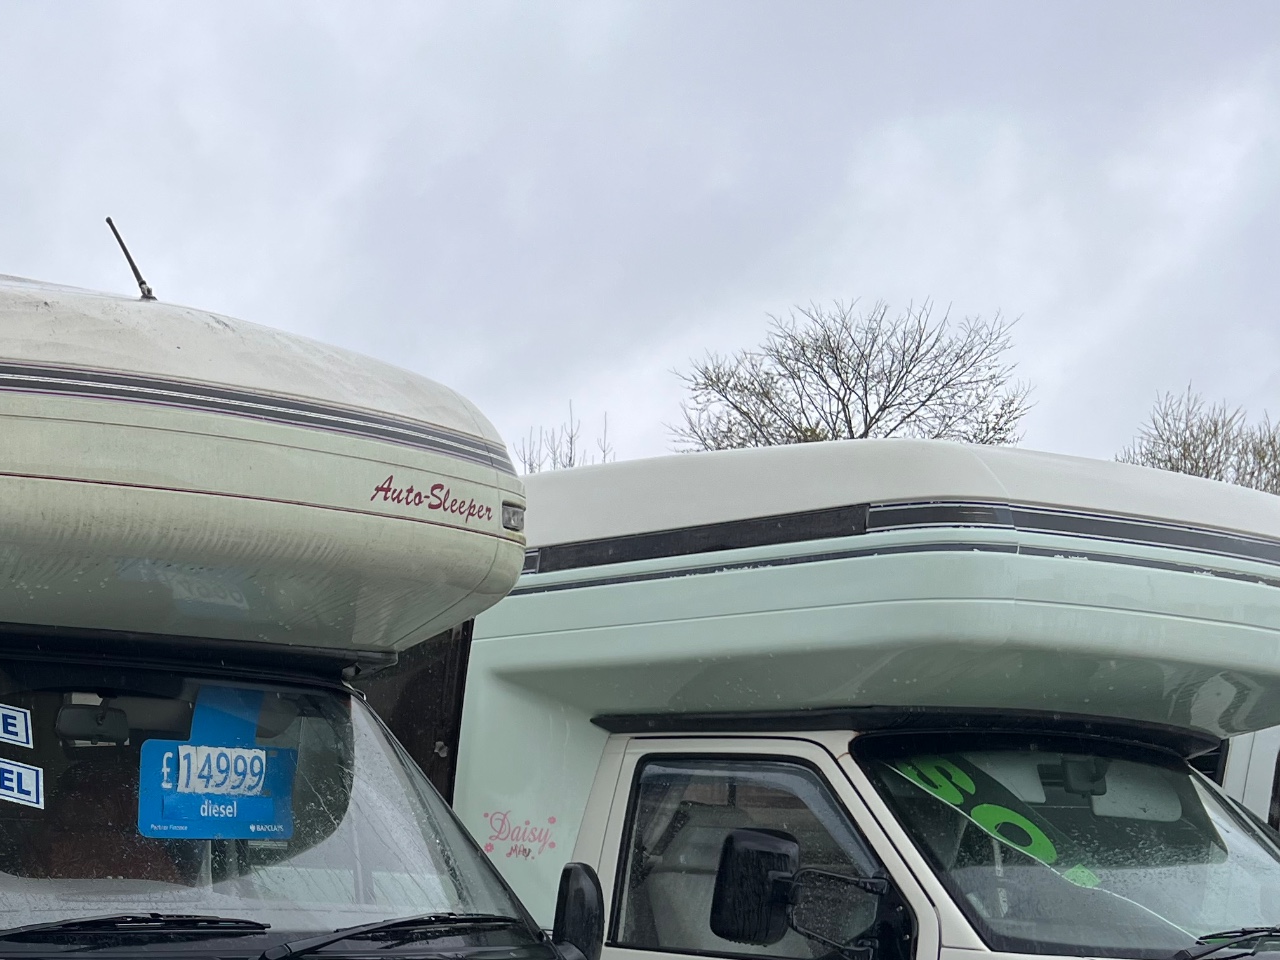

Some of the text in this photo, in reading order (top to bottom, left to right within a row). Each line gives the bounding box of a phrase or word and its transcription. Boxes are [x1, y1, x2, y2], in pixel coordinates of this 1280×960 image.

[371, 475, 493, 523] Auto-Sleeper
[200, 799, 237, 818] diesel
[488, 810, 552, 856] Daisy
